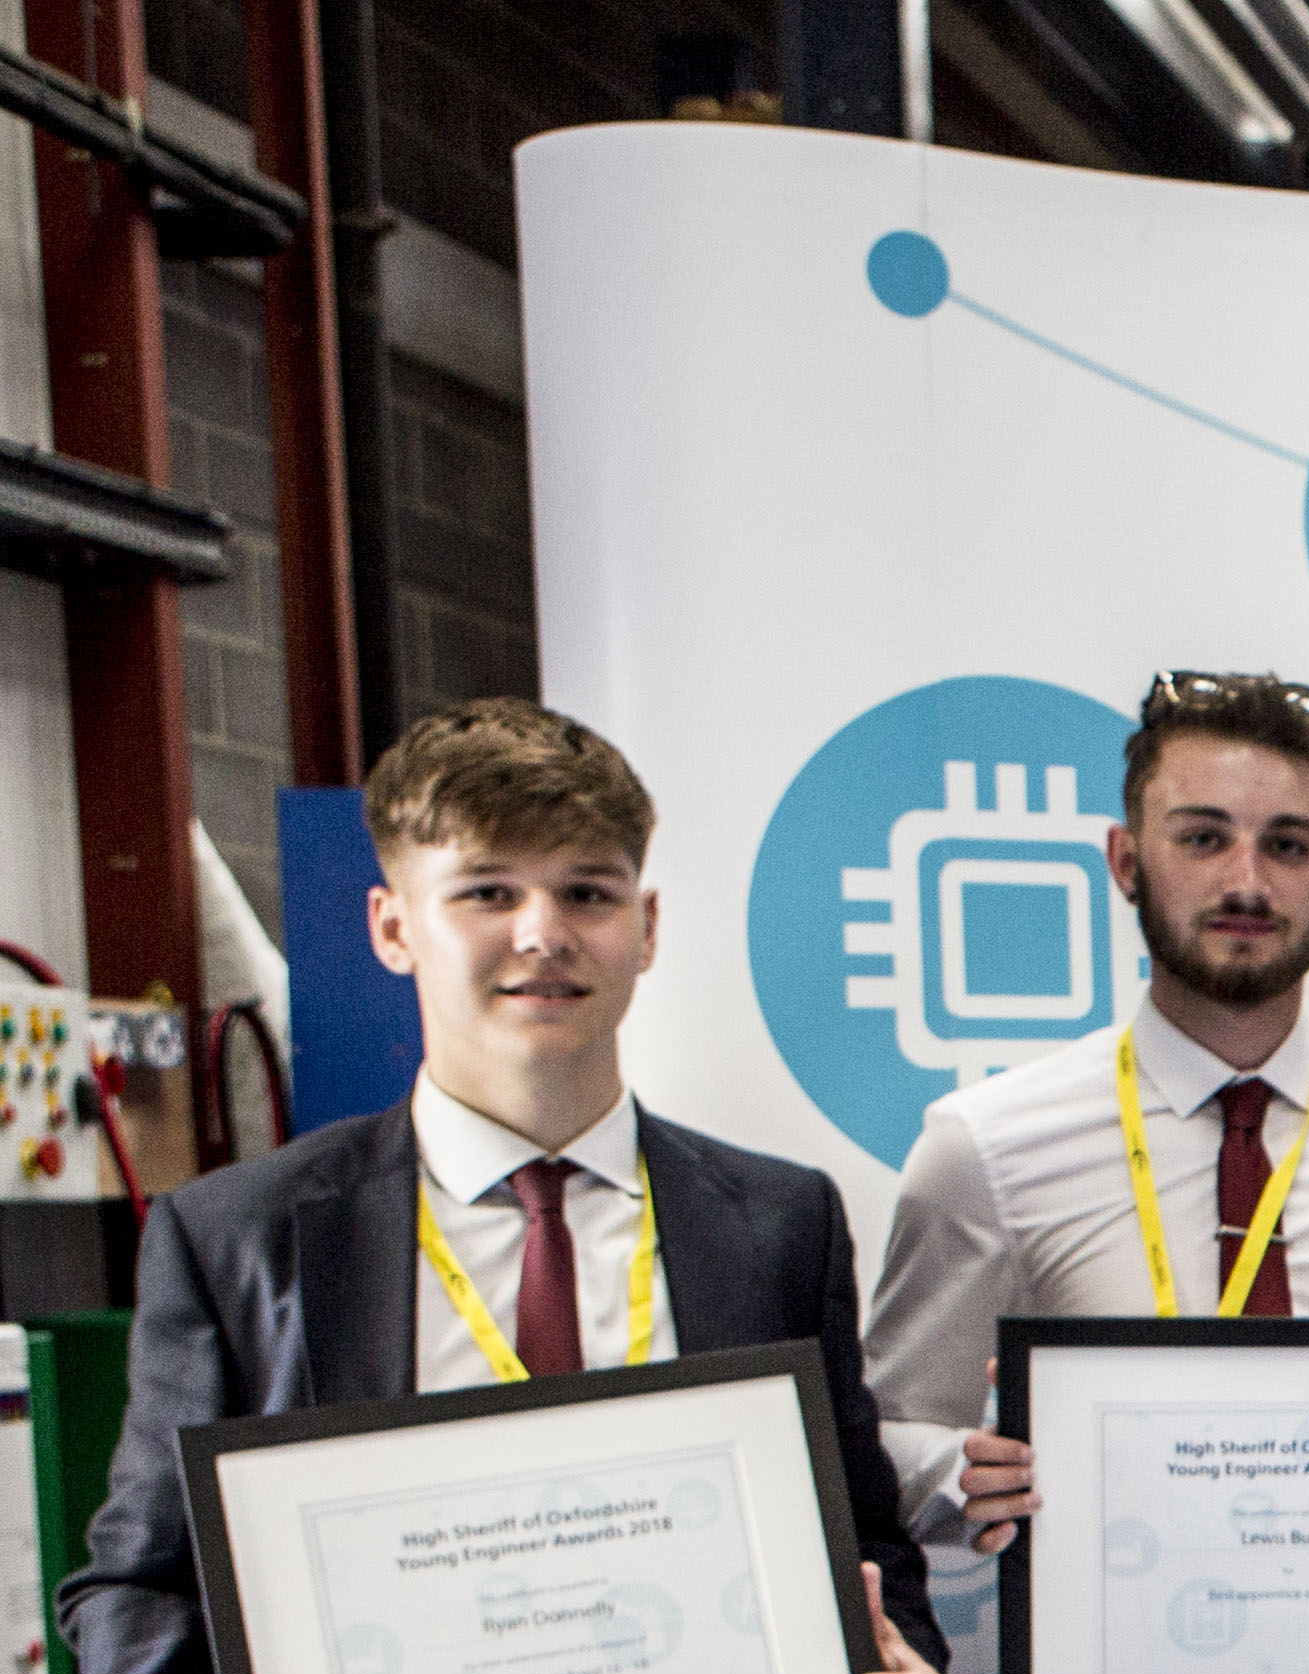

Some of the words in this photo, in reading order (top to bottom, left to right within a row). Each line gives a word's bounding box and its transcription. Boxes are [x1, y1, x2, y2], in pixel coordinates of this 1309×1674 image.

[1175, 1441, 1215, 1458] High
[1220, 1440, 1276, 1454] Sheriff
[1281, 1440, 1296, 1454] of
[1167, 1463, 1220, 1479] Young
[1225, 1462, 1299, 1479] Engineer
[402, 1529, 448, 1548] High
[453, 1516, 516, 1540] Sheriff
[522, 1514, 542, 1530] of
[546, 1499, 658, 1526] Oxfordshire
[396, 1552, 459, 1570] Young
[463, 1539, 547, 1562] Engineer
[554, 1526, 624, 1547] Awards
[630, 1517, 673, 1536] 2018
[1241, 1531, 1285, 1545] Lewis
[482, 1616, 528, 1636] Ryan
[532, 1601, 616, 1626] Donnelly
